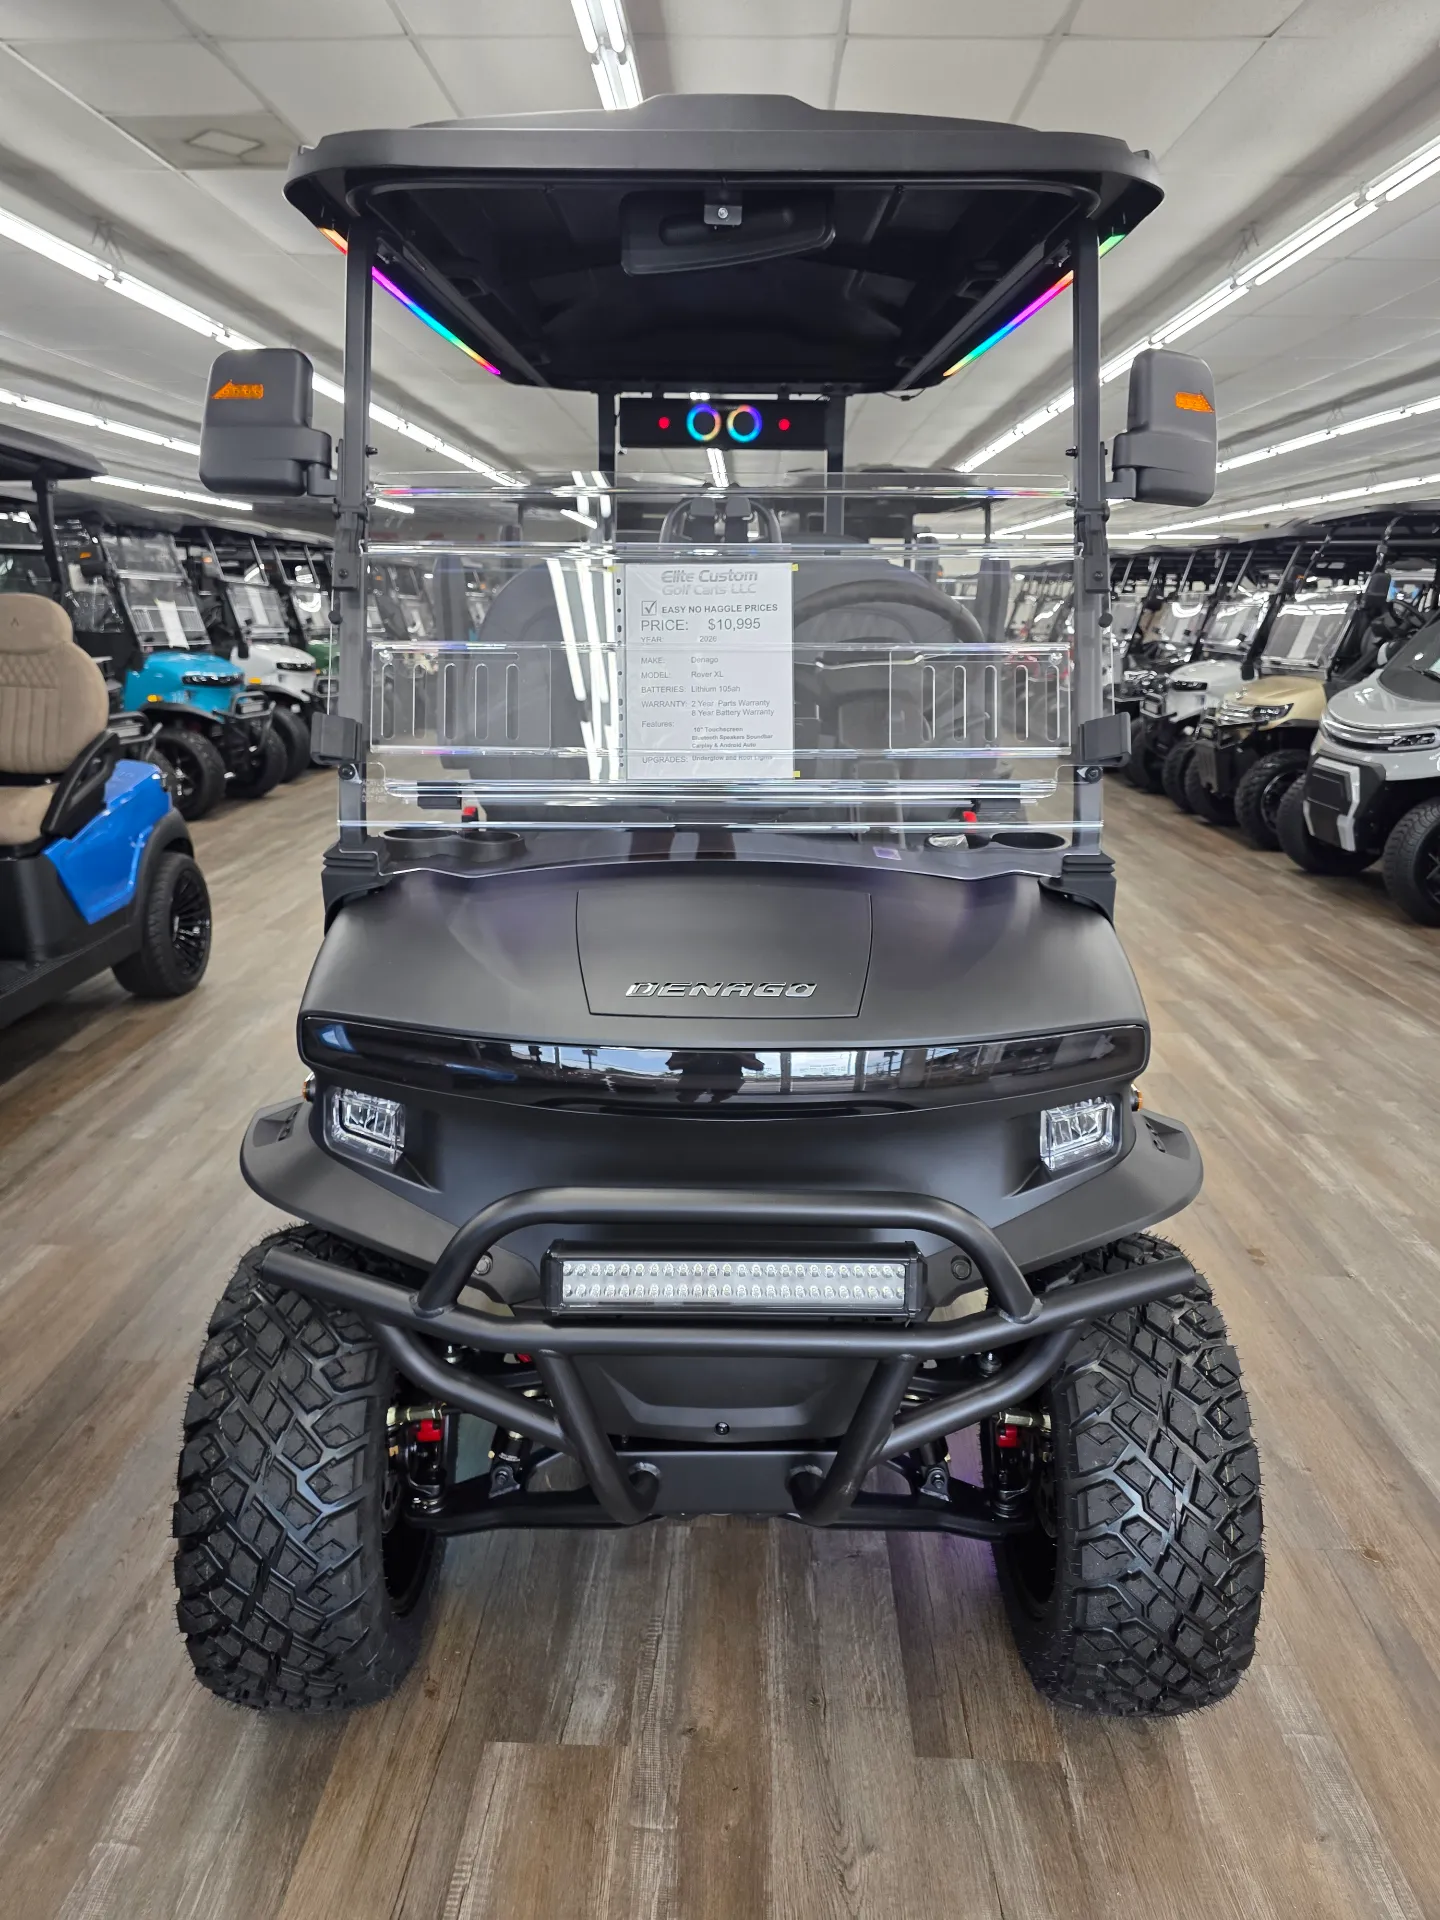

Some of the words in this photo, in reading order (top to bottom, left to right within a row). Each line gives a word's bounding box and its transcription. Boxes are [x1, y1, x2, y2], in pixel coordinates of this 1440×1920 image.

[661, 570, 695, 583] Elite
[698, 569, 758, 582] Custom
[662, 585, 691, 596] Golf
[693, 584, 728, 596] Carts
[730, 583, 757, 594] LLC
[661, 606, 686, 614] EASY
[688, 605, 702, 613] NO
[704, 605, 742, 613] HAGGLE
[744, 604, 778, 612] PRICES
[641, 619, 689, 631] PRICE:
[708, 617, 761, 632] $10,995
[699, 635, 718, 643] 2026
[690, 656, 719, 665] Denago
[640, 671, 671, 679] MODEL:
[690, 670, 712, 678] Rover
[713, 670, 724, 678] XL
[641, 685, 686, 693] BATTERIES:
[691, 685, 717, 693] Lithium
[719, 684, 741, 693] 105ah
[641, 700, 688, 708] WARRANTY:
[691, 700, 696, 708] 2
[717, 699, 737, 707] Parts
[738, 699, 770, 708] Warranty
[691, 709, 696, 717] 8
[697, 709, 714, 717] Year
[715, 708, 740, 718] Battery
[742, 708, 775, 717] Warranty
[641, 720, 675, 728] Features:
[705, 725, 744, 733] Touchscreen
[719, 733, 745, 741] Speakers
[746, 732, 774, 740] Soundbar
[719, 741, 742, 749] Android
[641, 755, 689, 764] UPGRADES:
[625, 982, 818, 998] DENAGO
